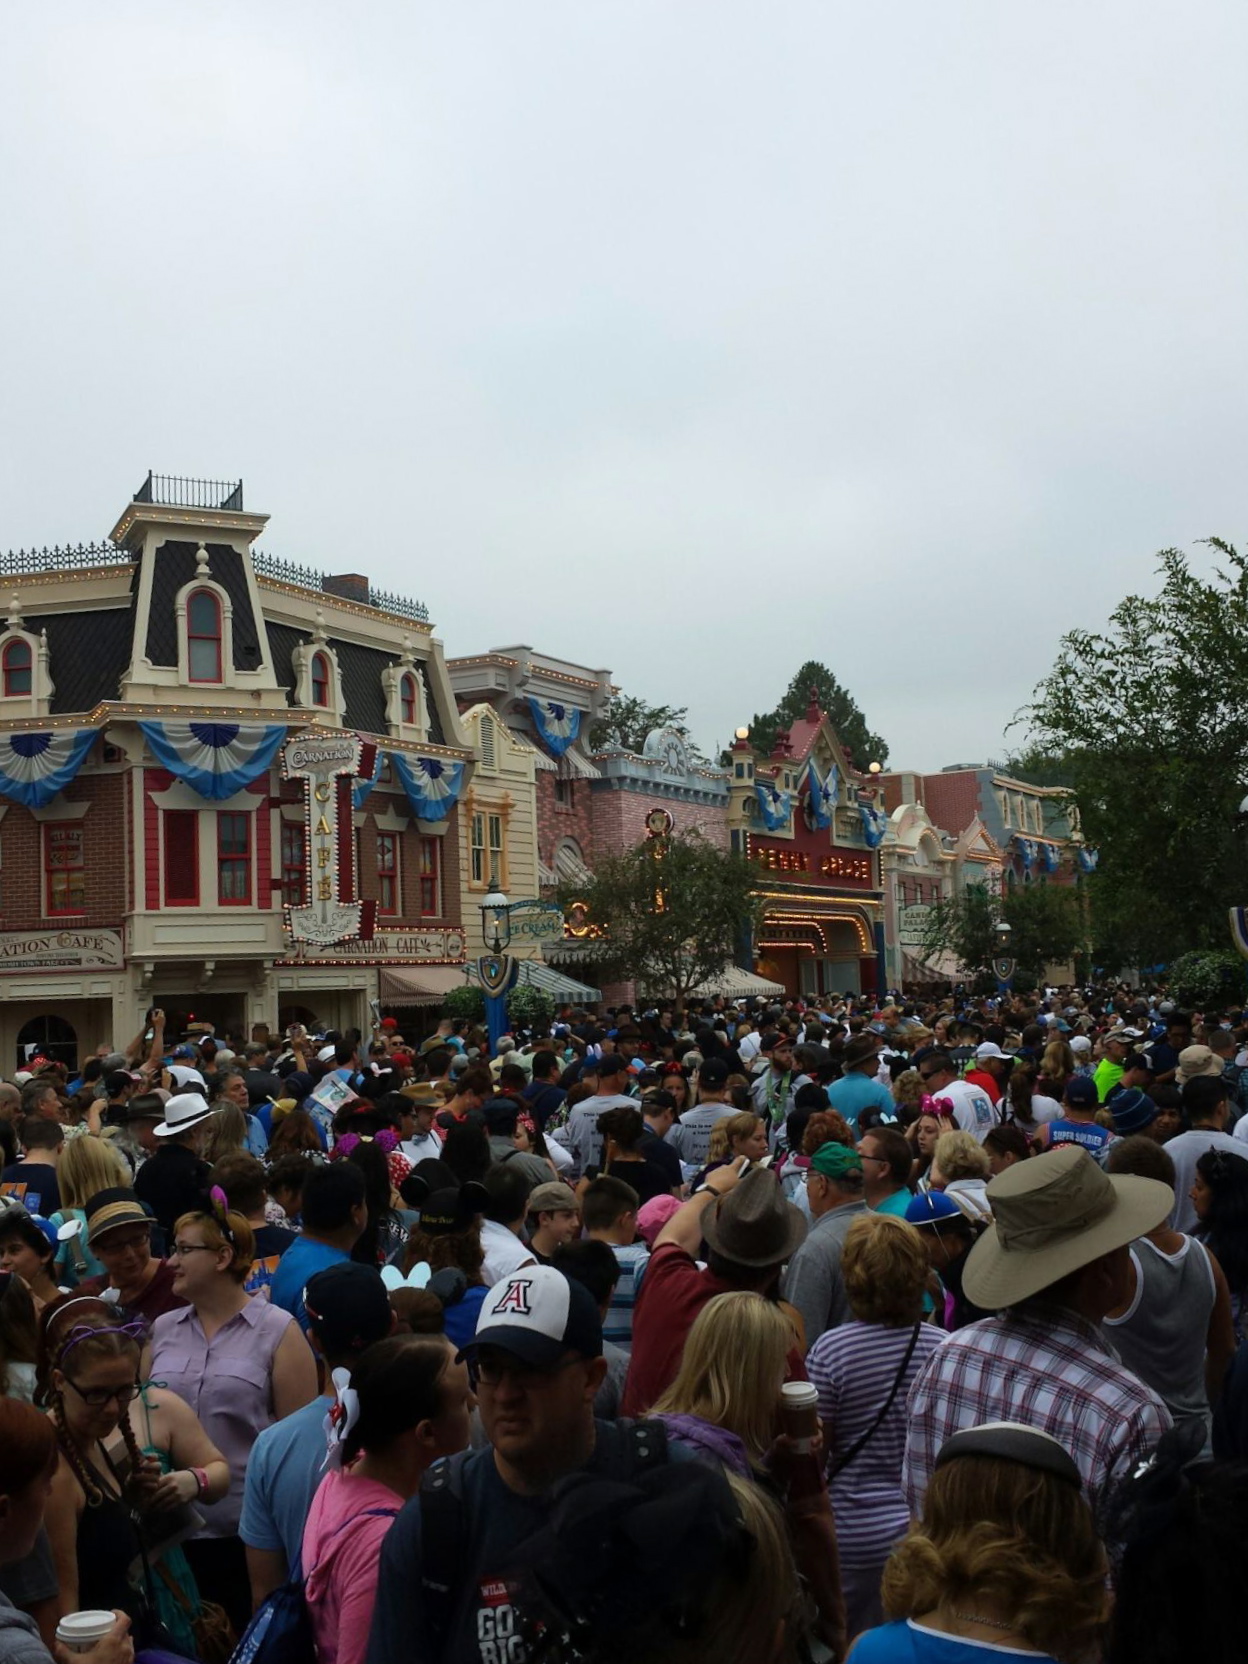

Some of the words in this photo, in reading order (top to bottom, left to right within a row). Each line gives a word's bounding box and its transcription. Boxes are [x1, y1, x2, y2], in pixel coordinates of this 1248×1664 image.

[291, 748, 354, 768] CARNATION
[1053, 1131, 1074, 1141] SUPER
[1075, 1133, 1102, 1146] SOLDIER
[491, 1280, 533, 1315] A
[481, 1583, 508, 1596] WILD
[477, 1604, 514, 1640] GO
[478, 1635, 527, 1664] BIG
